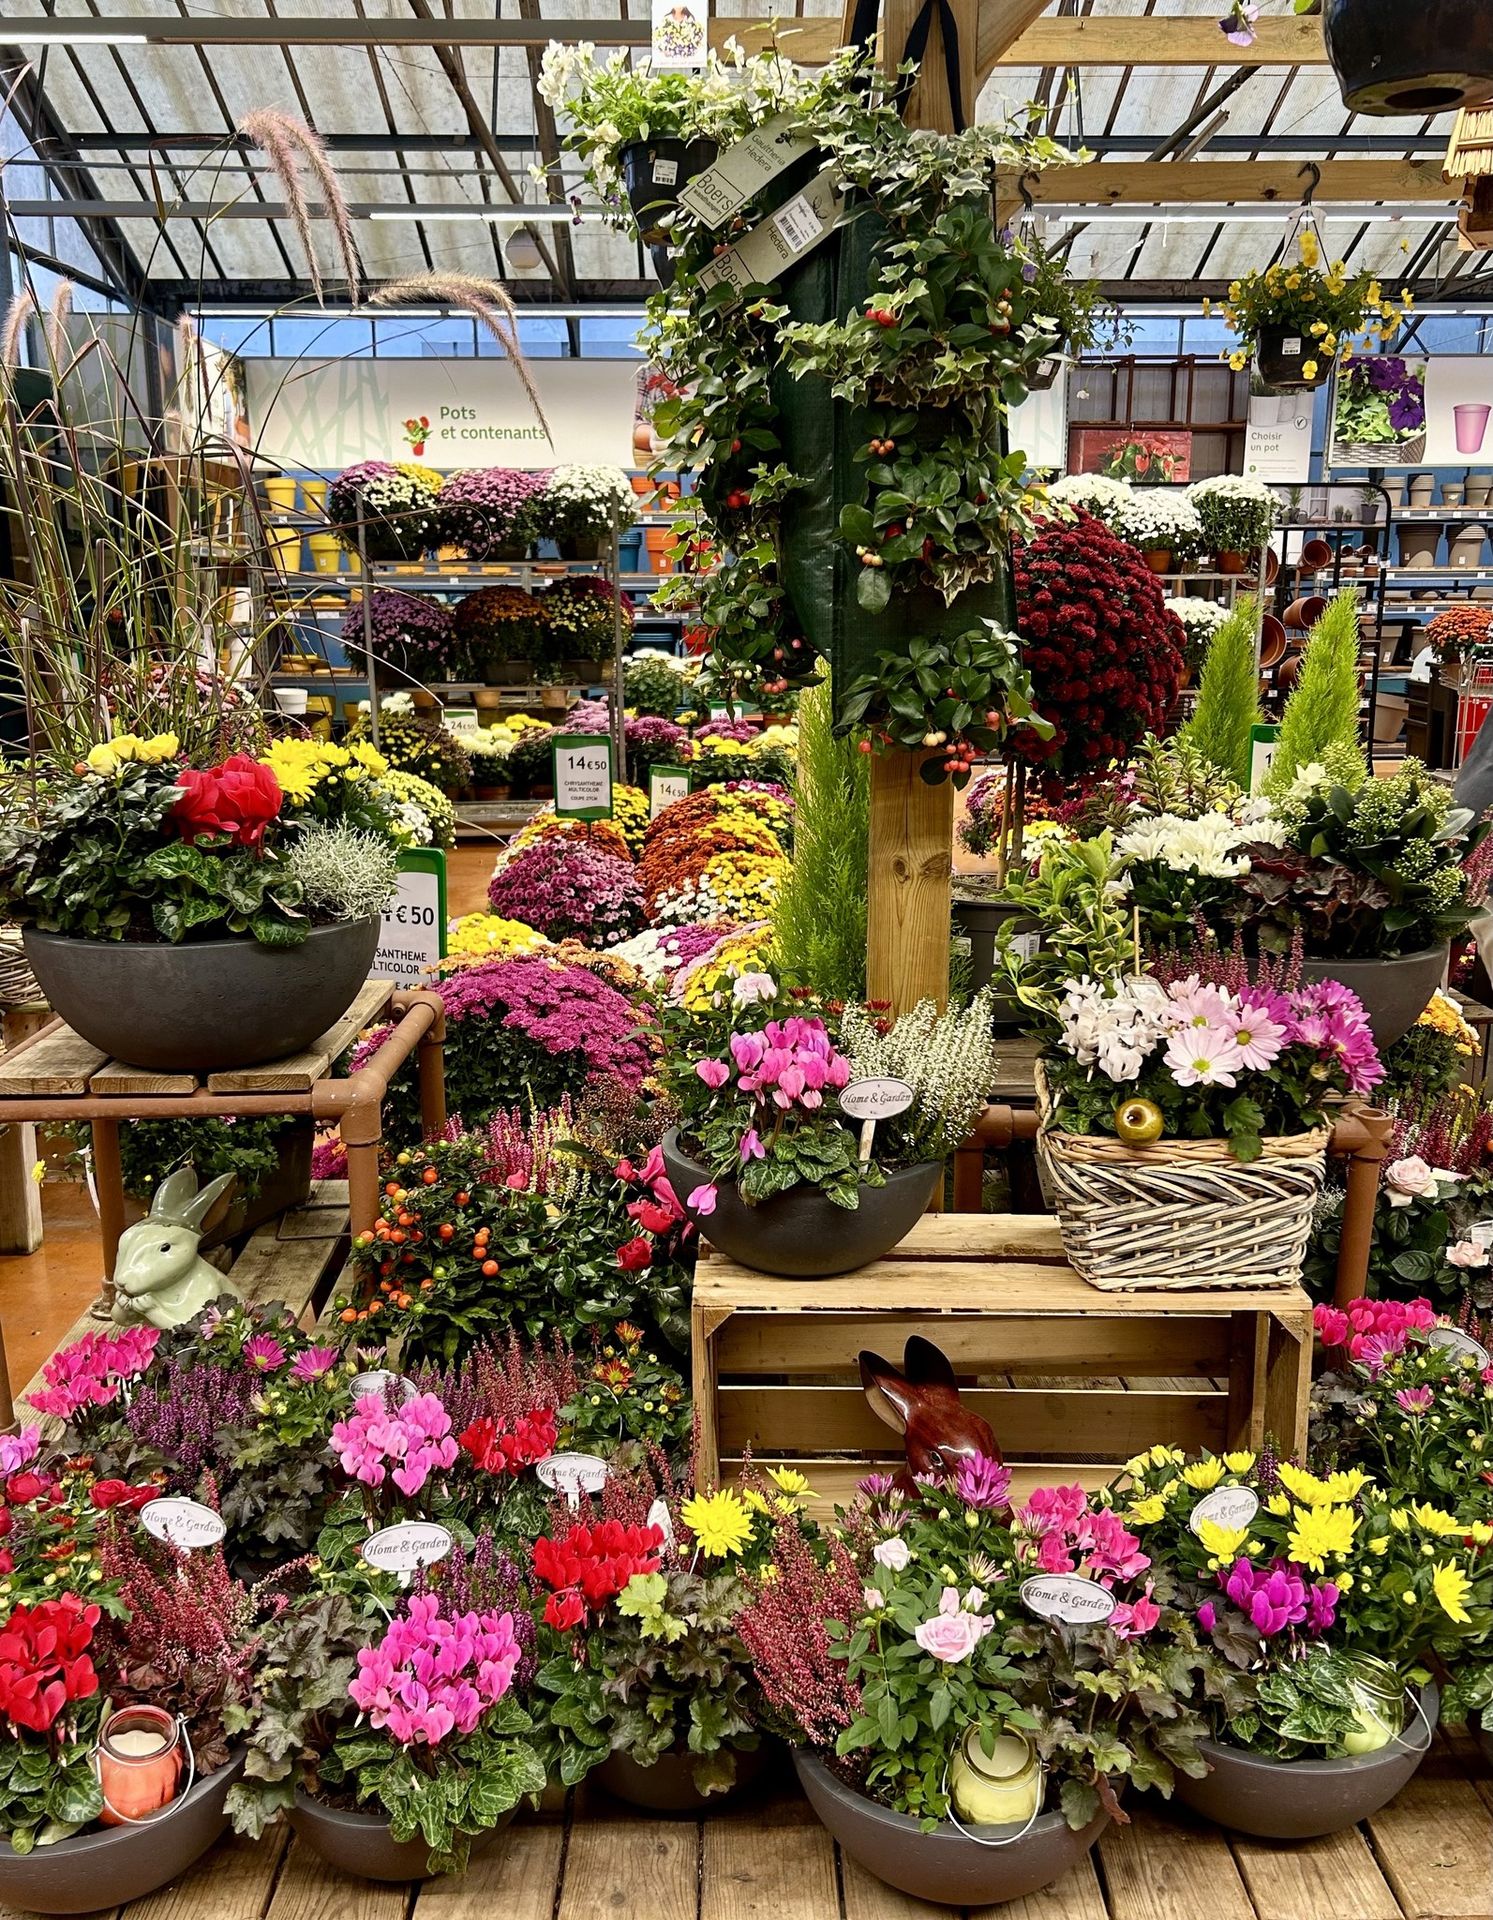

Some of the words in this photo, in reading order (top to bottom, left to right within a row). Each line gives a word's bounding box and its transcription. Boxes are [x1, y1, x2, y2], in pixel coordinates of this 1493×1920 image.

[744, 144, 772, 172] Hedera
[751, 133, 786, 167] Gaultheria
[697, 174, 734, 211] Boers
[767, 225, 789, 260] Hedera
[440, 406, 476, 420] Pots
[441, 426, 456, 440] et
[460, 426, 546, 440] contenants
[1251, 431, 1282, 441] Choisir
[1250, 444, 1262, 452] un
[1263, 443, 1280, 454] pot
[376, 947, 427, 962] SANTHEME
[842, 1094, 869, 1104] Home
[870, 1092, 879, 1103] &
[879, 1091, 911, 1105] Garden
[568, 1467, 577, 1478] &
[144, 1511, 174, 1526] Home
[175, 1515, 185, 1528] &
[186, 1518, 222, 1534] Garden
[366, 1543, 400, 1557] Home
[400, 1540, 410, 1553] &
[411, 1536, 448, 1555] Garden
[1026, 1585, 1058, 1601] Home
[1059, 1591, 1070, 1604] &
[1071, 1595, 1112, 1612] Garden
